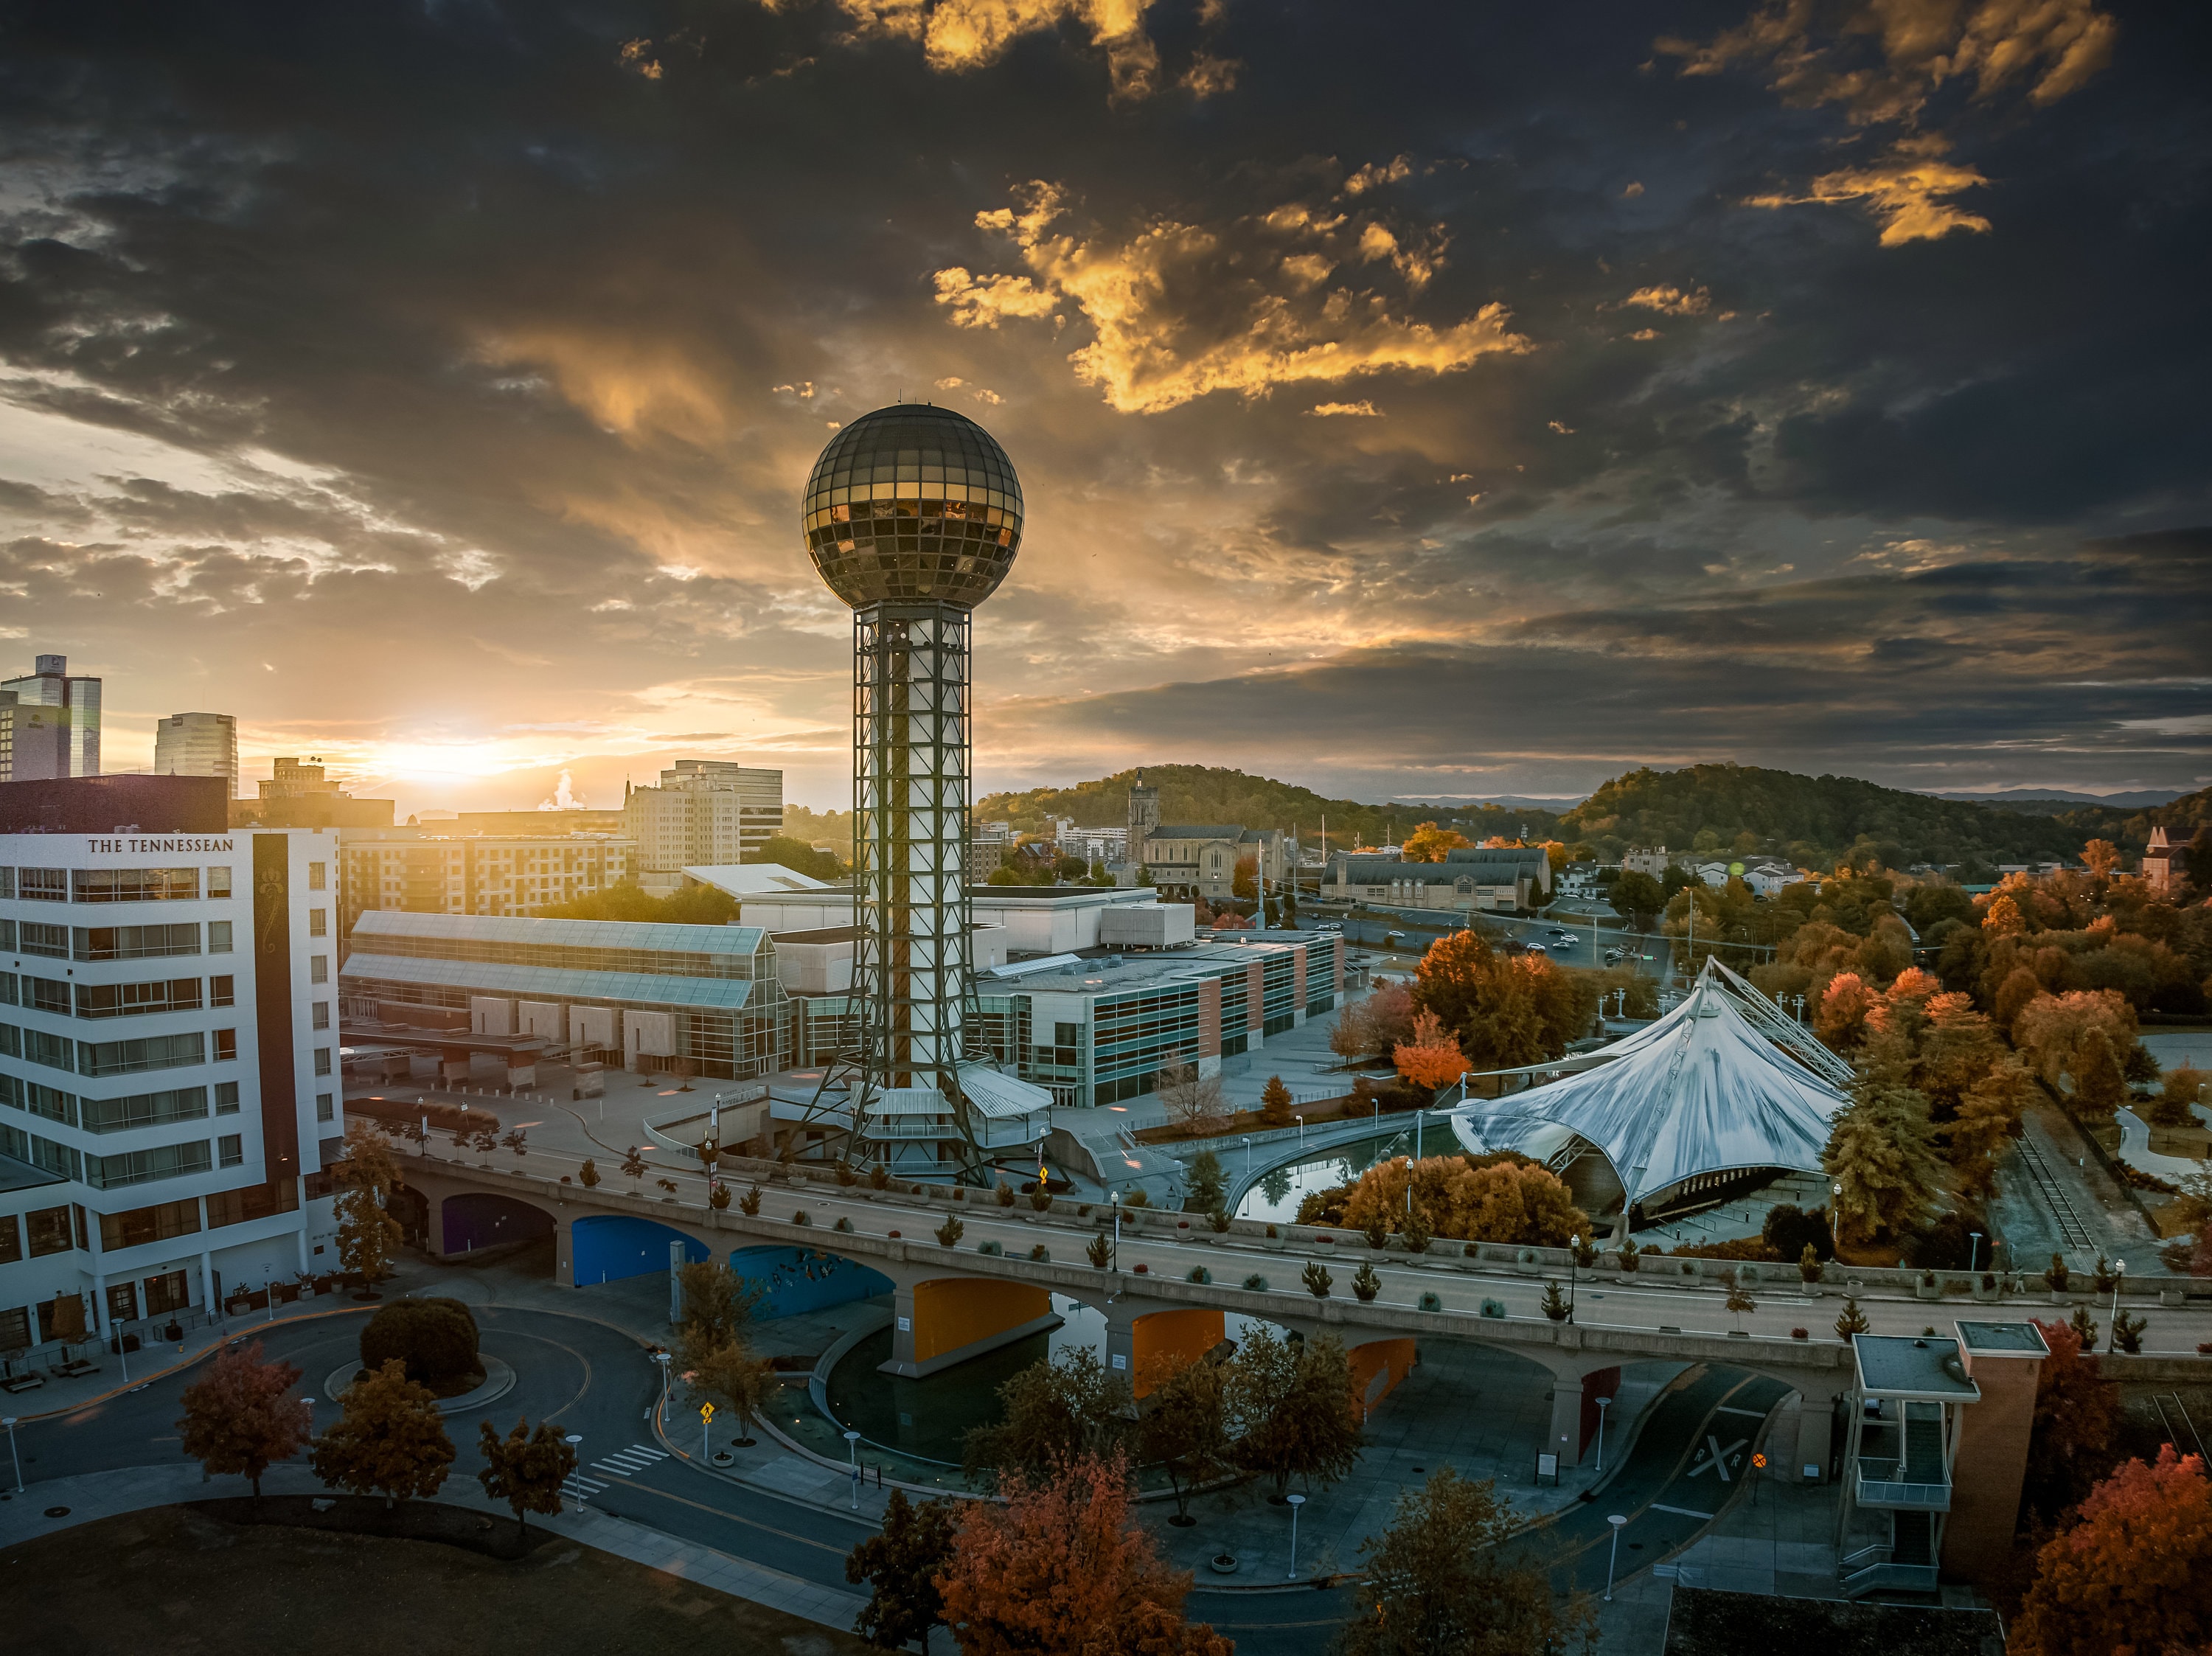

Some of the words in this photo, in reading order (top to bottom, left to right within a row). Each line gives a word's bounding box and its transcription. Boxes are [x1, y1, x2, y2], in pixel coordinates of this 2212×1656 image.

[88, 839, 122, 853] THE
[128, 839, 234, 853] TENNESSEAN
[1694, 1448, 1705, 1461] R
[1731, 1453, 1741, 1467] R
